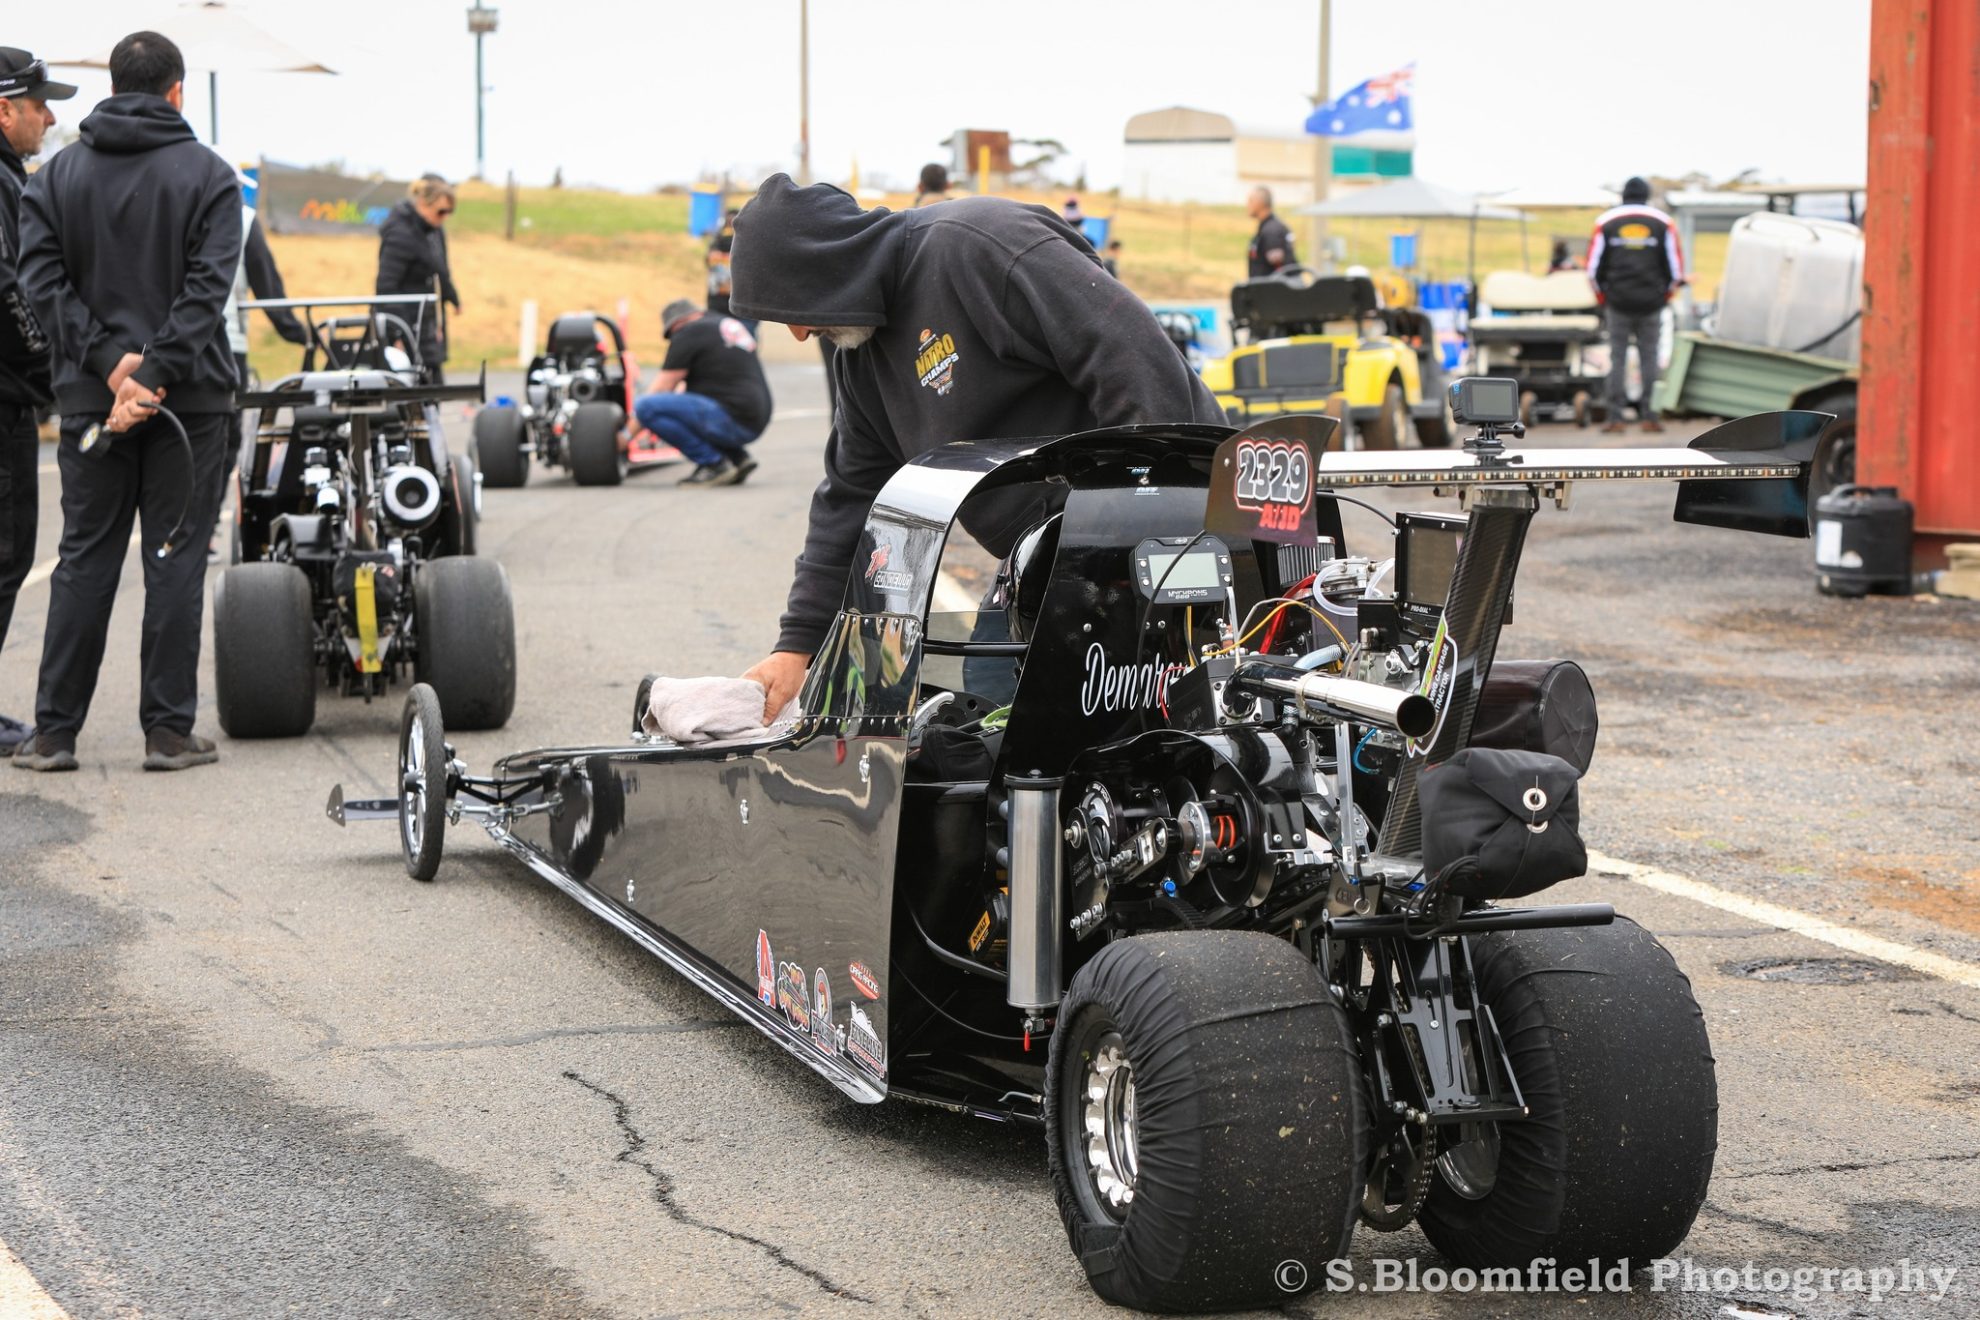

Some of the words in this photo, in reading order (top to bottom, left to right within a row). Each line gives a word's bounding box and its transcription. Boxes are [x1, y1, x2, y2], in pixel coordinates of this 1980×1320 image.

[915, 333, 955, 379] NITRO
[921, 352, 959, 387] CHAMPS
[1237, 446, 1309, 504] 2329
[1435, 643, 1449, 682] CARTAGE
